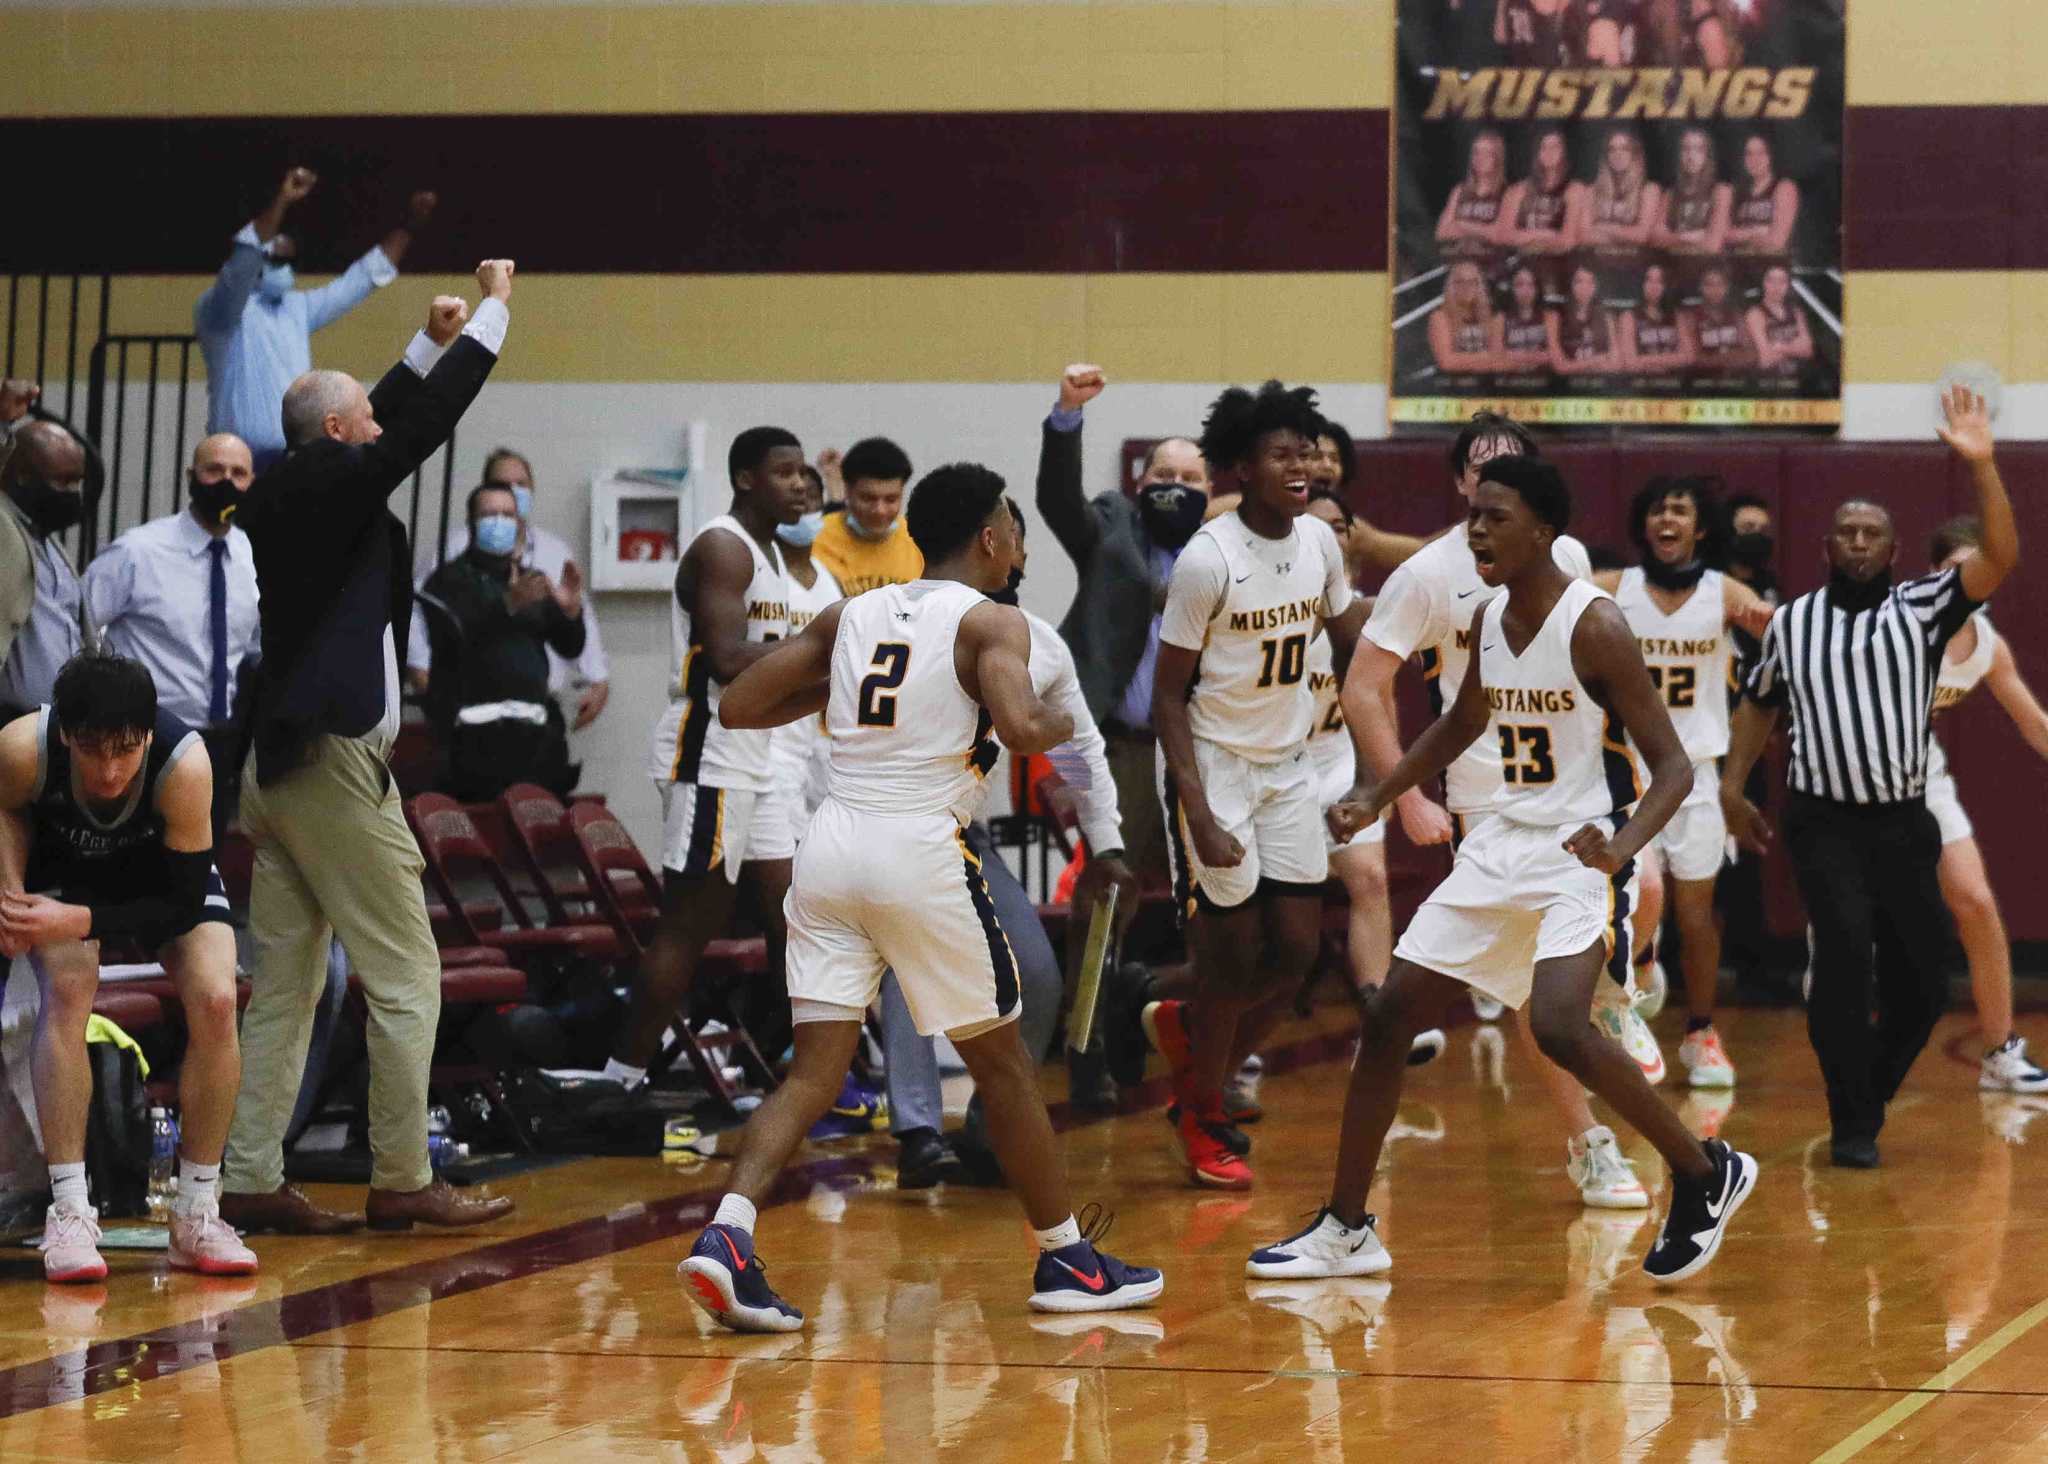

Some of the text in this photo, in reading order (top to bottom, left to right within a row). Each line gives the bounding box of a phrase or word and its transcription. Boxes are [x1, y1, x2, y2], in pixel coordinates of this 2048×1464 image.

[1424, 67, 1816, 119] MUSTANGS
[858, 643, 912, 729] 2
[1257, 633, 1307, 688] 10
